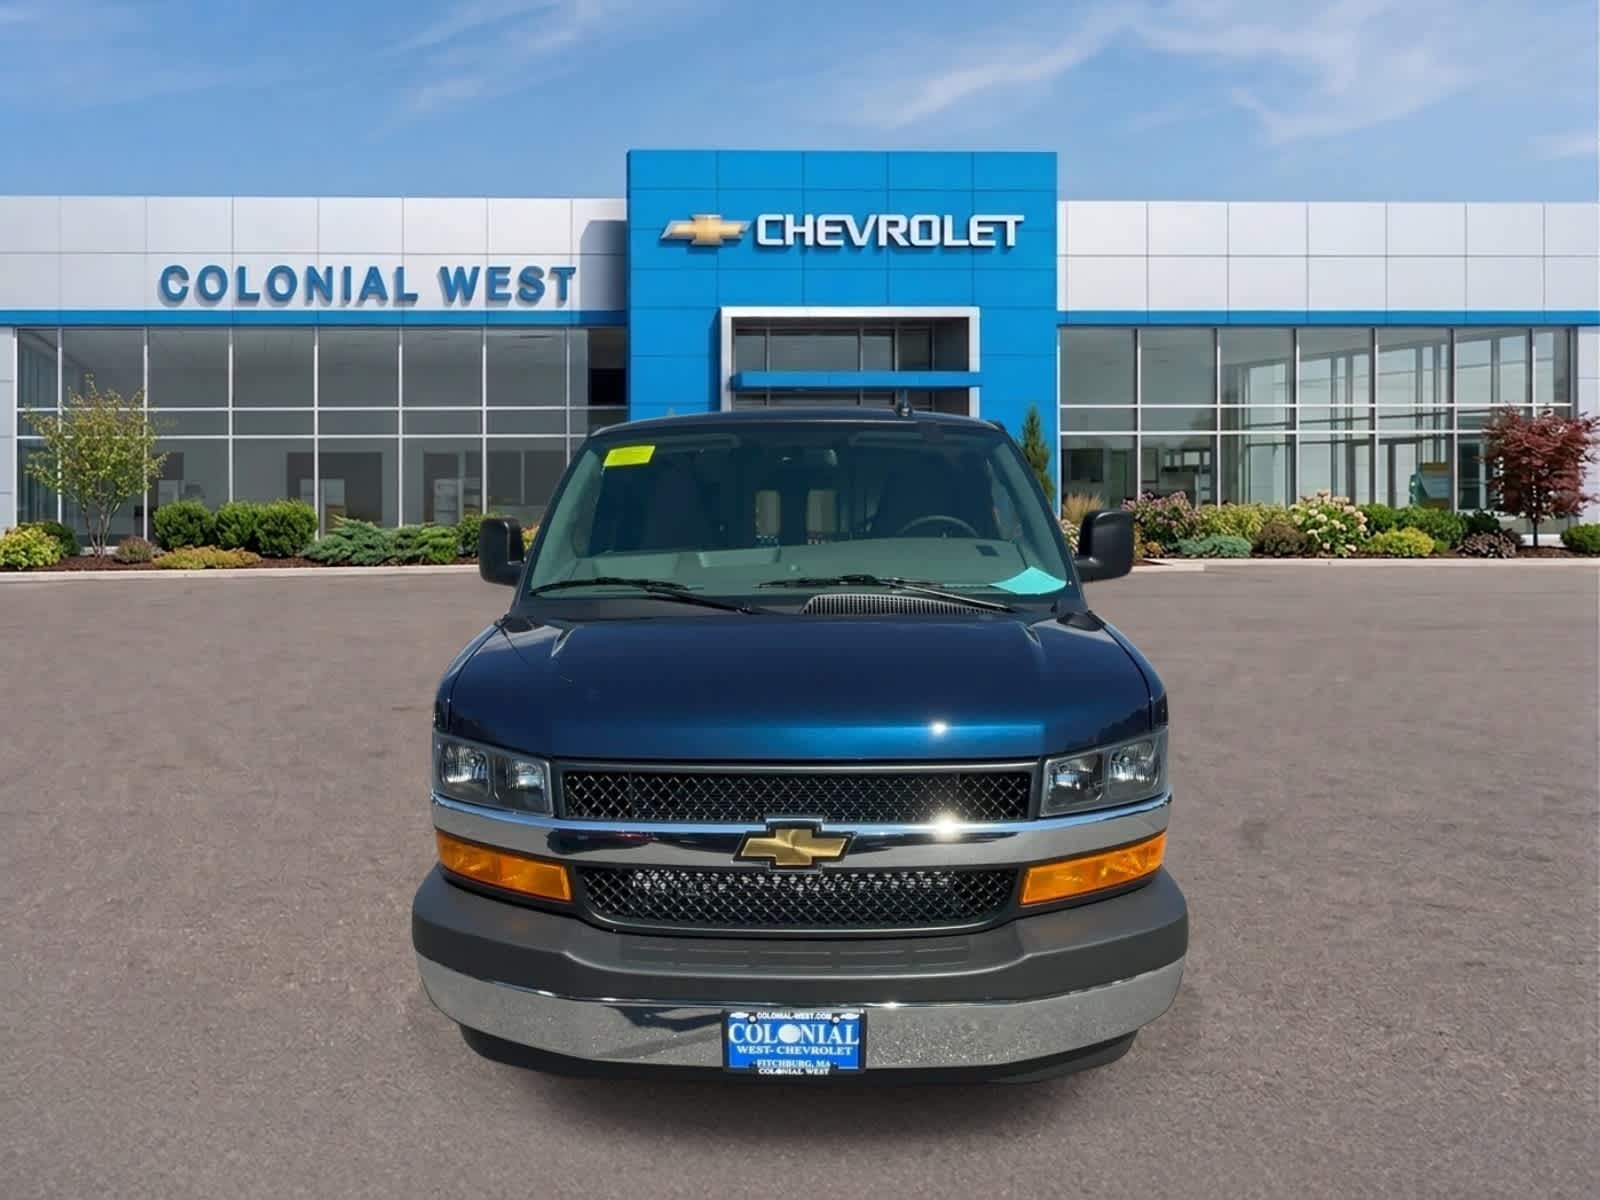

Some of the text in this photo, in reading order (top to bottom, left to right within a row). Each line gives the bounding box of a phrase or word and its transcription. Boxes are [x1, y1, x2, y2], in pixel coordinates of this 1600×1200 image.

[755, 213, 1025, 248] CHEVROLET
[160, 264, 577, 304] COLONIAL WEST
[728, 1023, 859, 1044] COLONIAL
[776, 1046, 852, 1055] CHEVROLET
